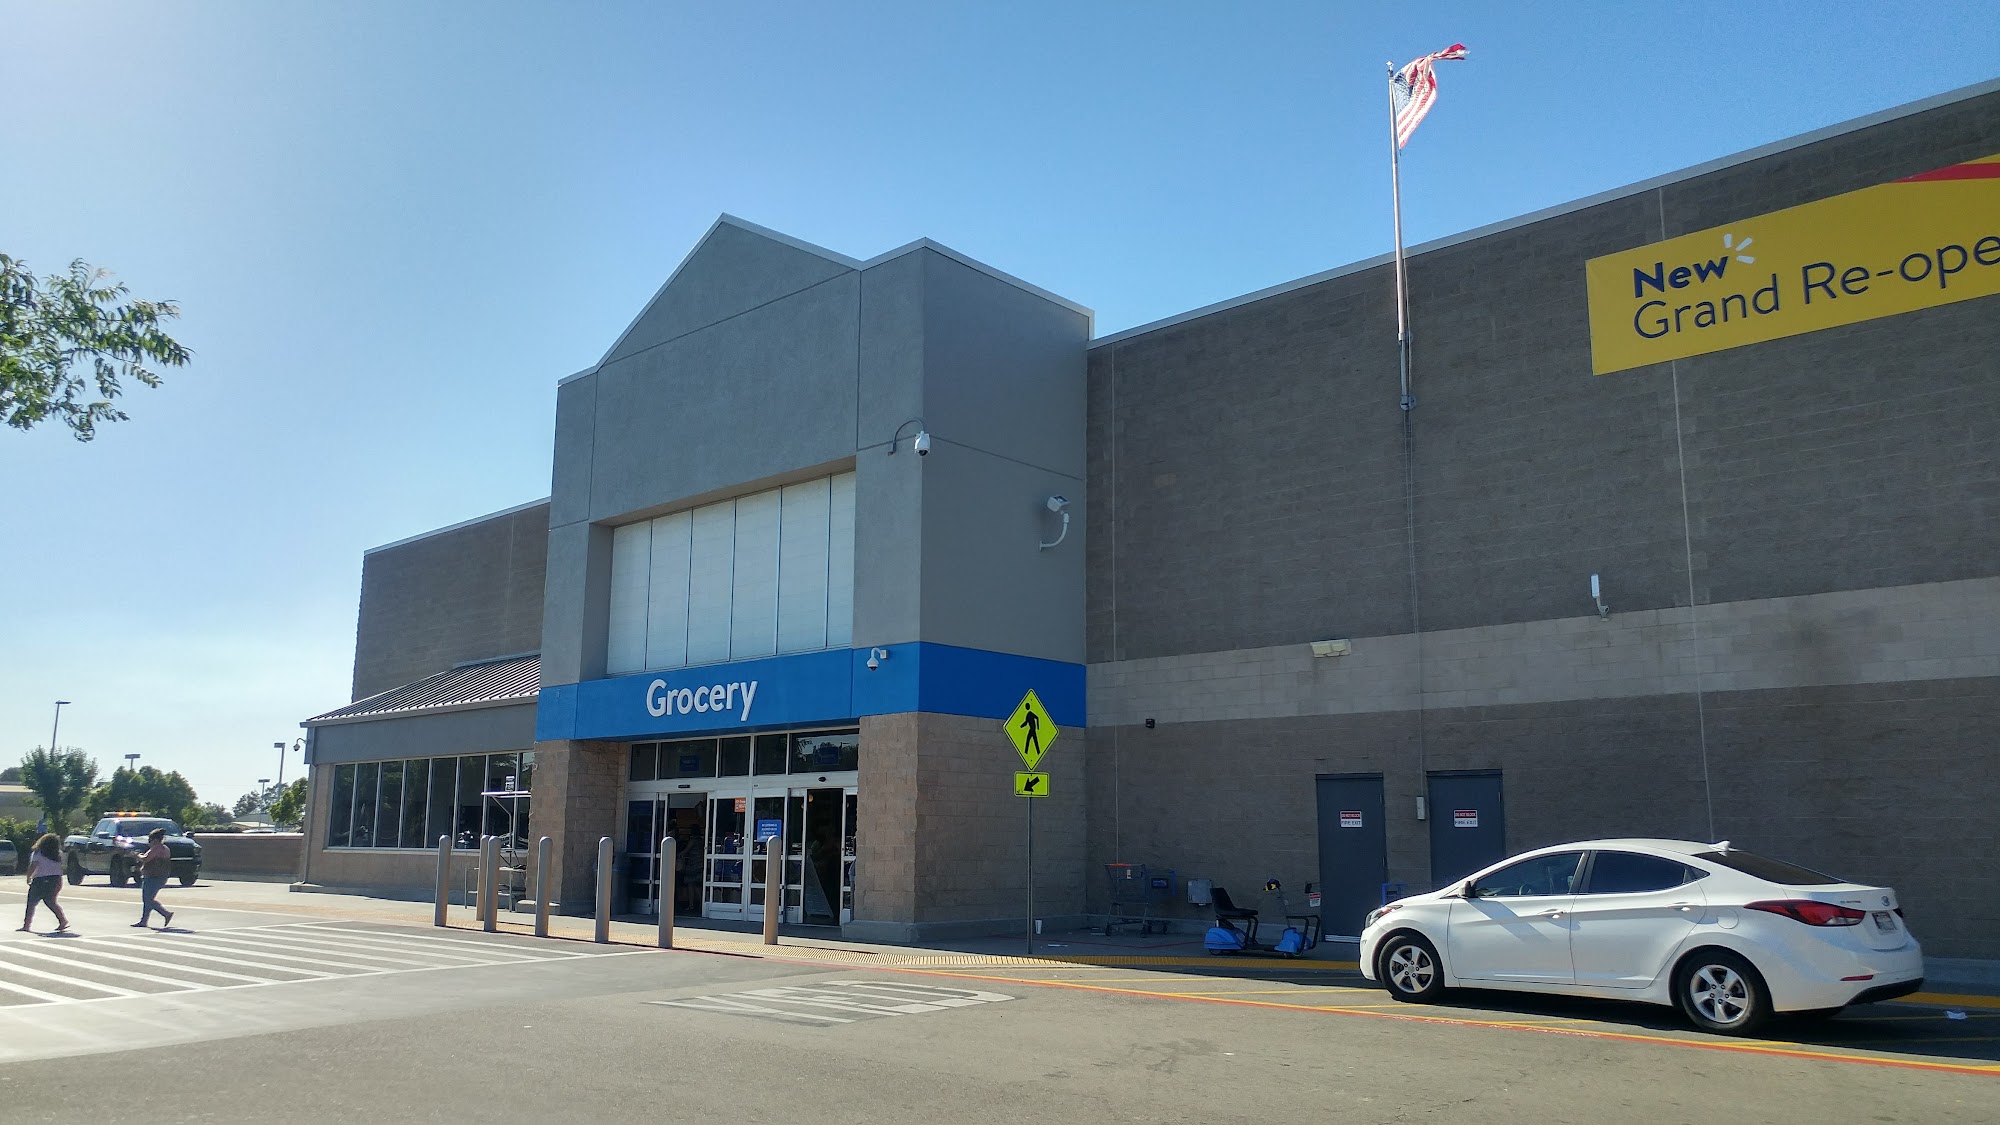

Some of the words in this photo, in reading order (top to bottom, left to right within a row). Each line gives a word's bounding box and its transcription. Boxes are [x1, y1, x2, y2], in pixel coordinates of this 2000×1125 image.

[1633, 255, 1729, 298] New
[1634, 273, 1780, 339] Grand
[1802, 235, 2000, 305] Re-ope
[646, 678, 758, 722] Grocery
[649, 980, 1016, 1024] YIELD
